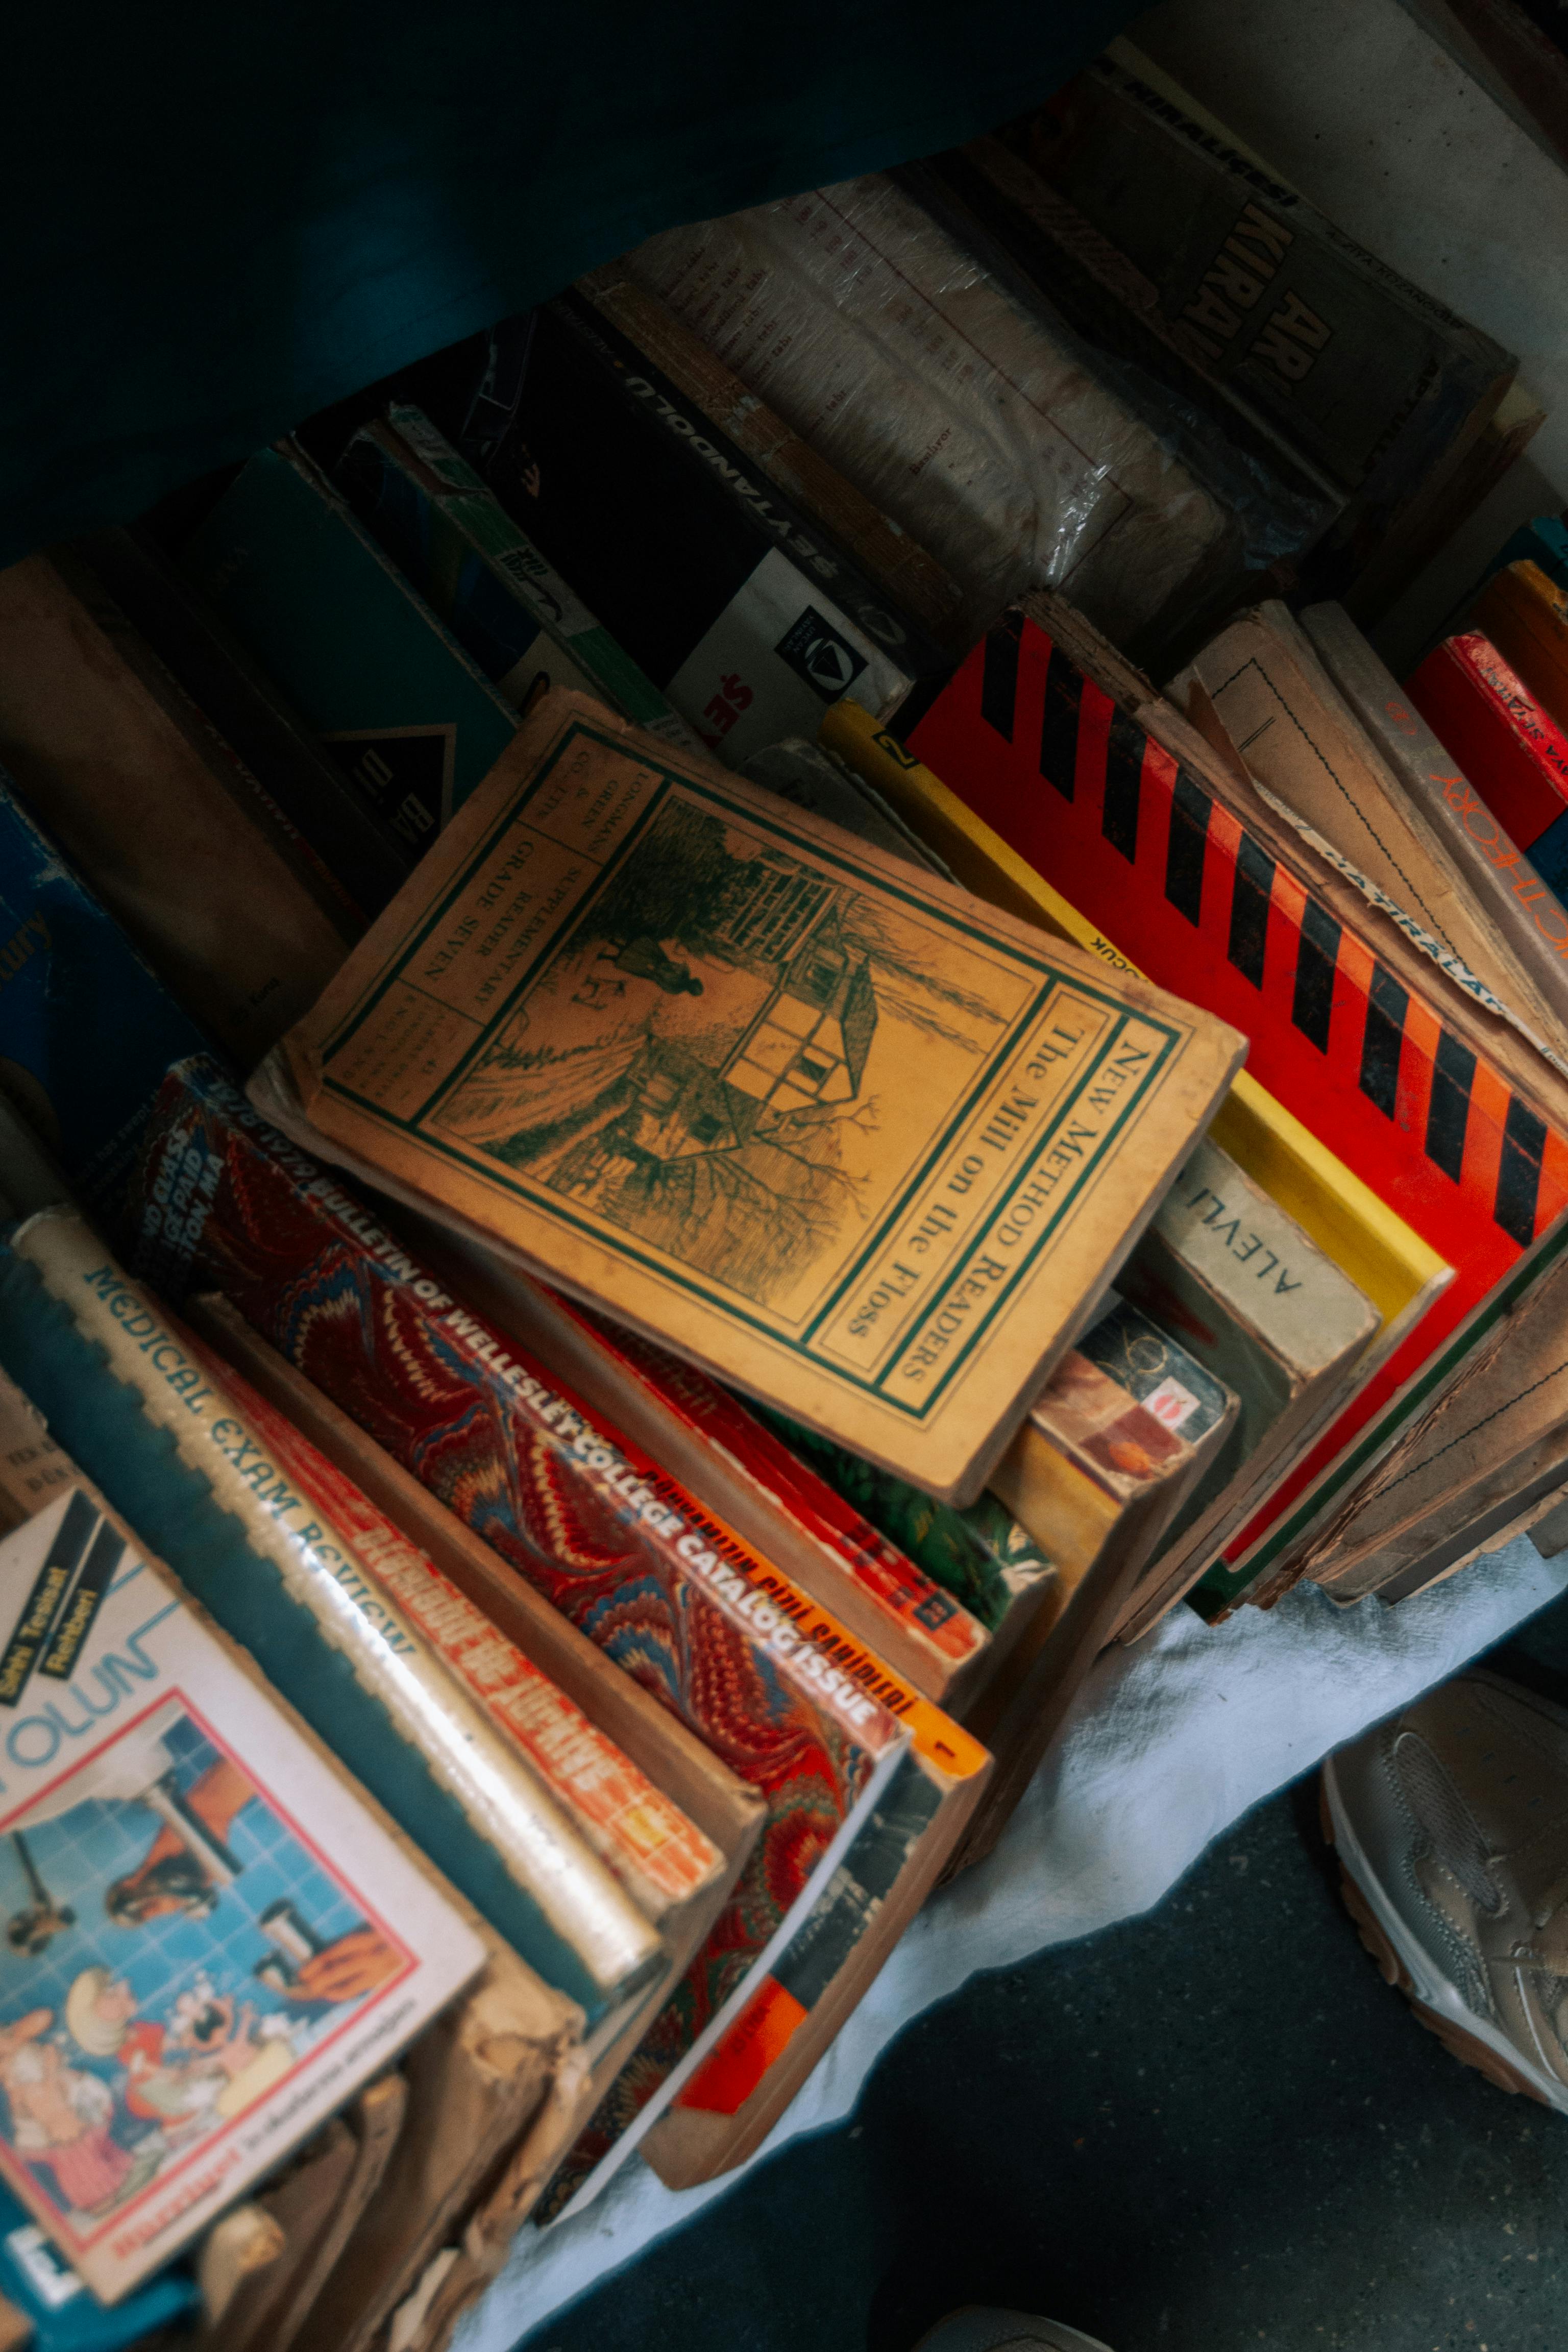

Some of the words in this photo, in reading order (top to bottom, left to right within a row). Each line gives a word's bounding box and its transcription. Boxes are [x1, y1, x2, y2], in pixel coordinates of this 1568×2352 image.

[574, 785, 590, 802] &
[578, 777, 622, 831] GREEN
[584, 769, 651, 856] LONGMANS
[473, 835, 537, 915] GRADE
[1426, 755, 1551, 918] THEORY
[423, 914, 481, 984] SEVEN
[471, 865, 581, 1008] SUPPLEMENTARY
[474, 887, 534, 962] READER
[1022, 1015, 1086, 1088] The
[976, 1083, 1040, 1156] Mill
[174, 1149, 203, 1211] PAID
[944, 1150, 987, 1198] on
[991, 1116, 1099, 1256] METHOD
[904, 1198, 960, 1261] the
[844, 1255, 923, 1350] Floss
[898, 1247, 1010, 1392] READERS
[80, 1257, 218, 1419] MEDICAL
[205, 1412, 303, 1525] EXAM
[284, 1517, 419, 1672] REVIEW
[307, 1173, 421, 1283] BULLETIN
[407, 1271, 457, 1319] OF
[438, 1303, 582, 1439] WELLESLEY
[570, 1429, 687, 1540] COLLEGE
[669, 1527, 804, 1655] CATALOG
[789, 1641, 881, 1729] ISSUE
[19, 1563, 69, 1639] Tesisat
[45, 1587, 99, 1672] Rehberi
[5, 1639, 159, 1769] OLUN
